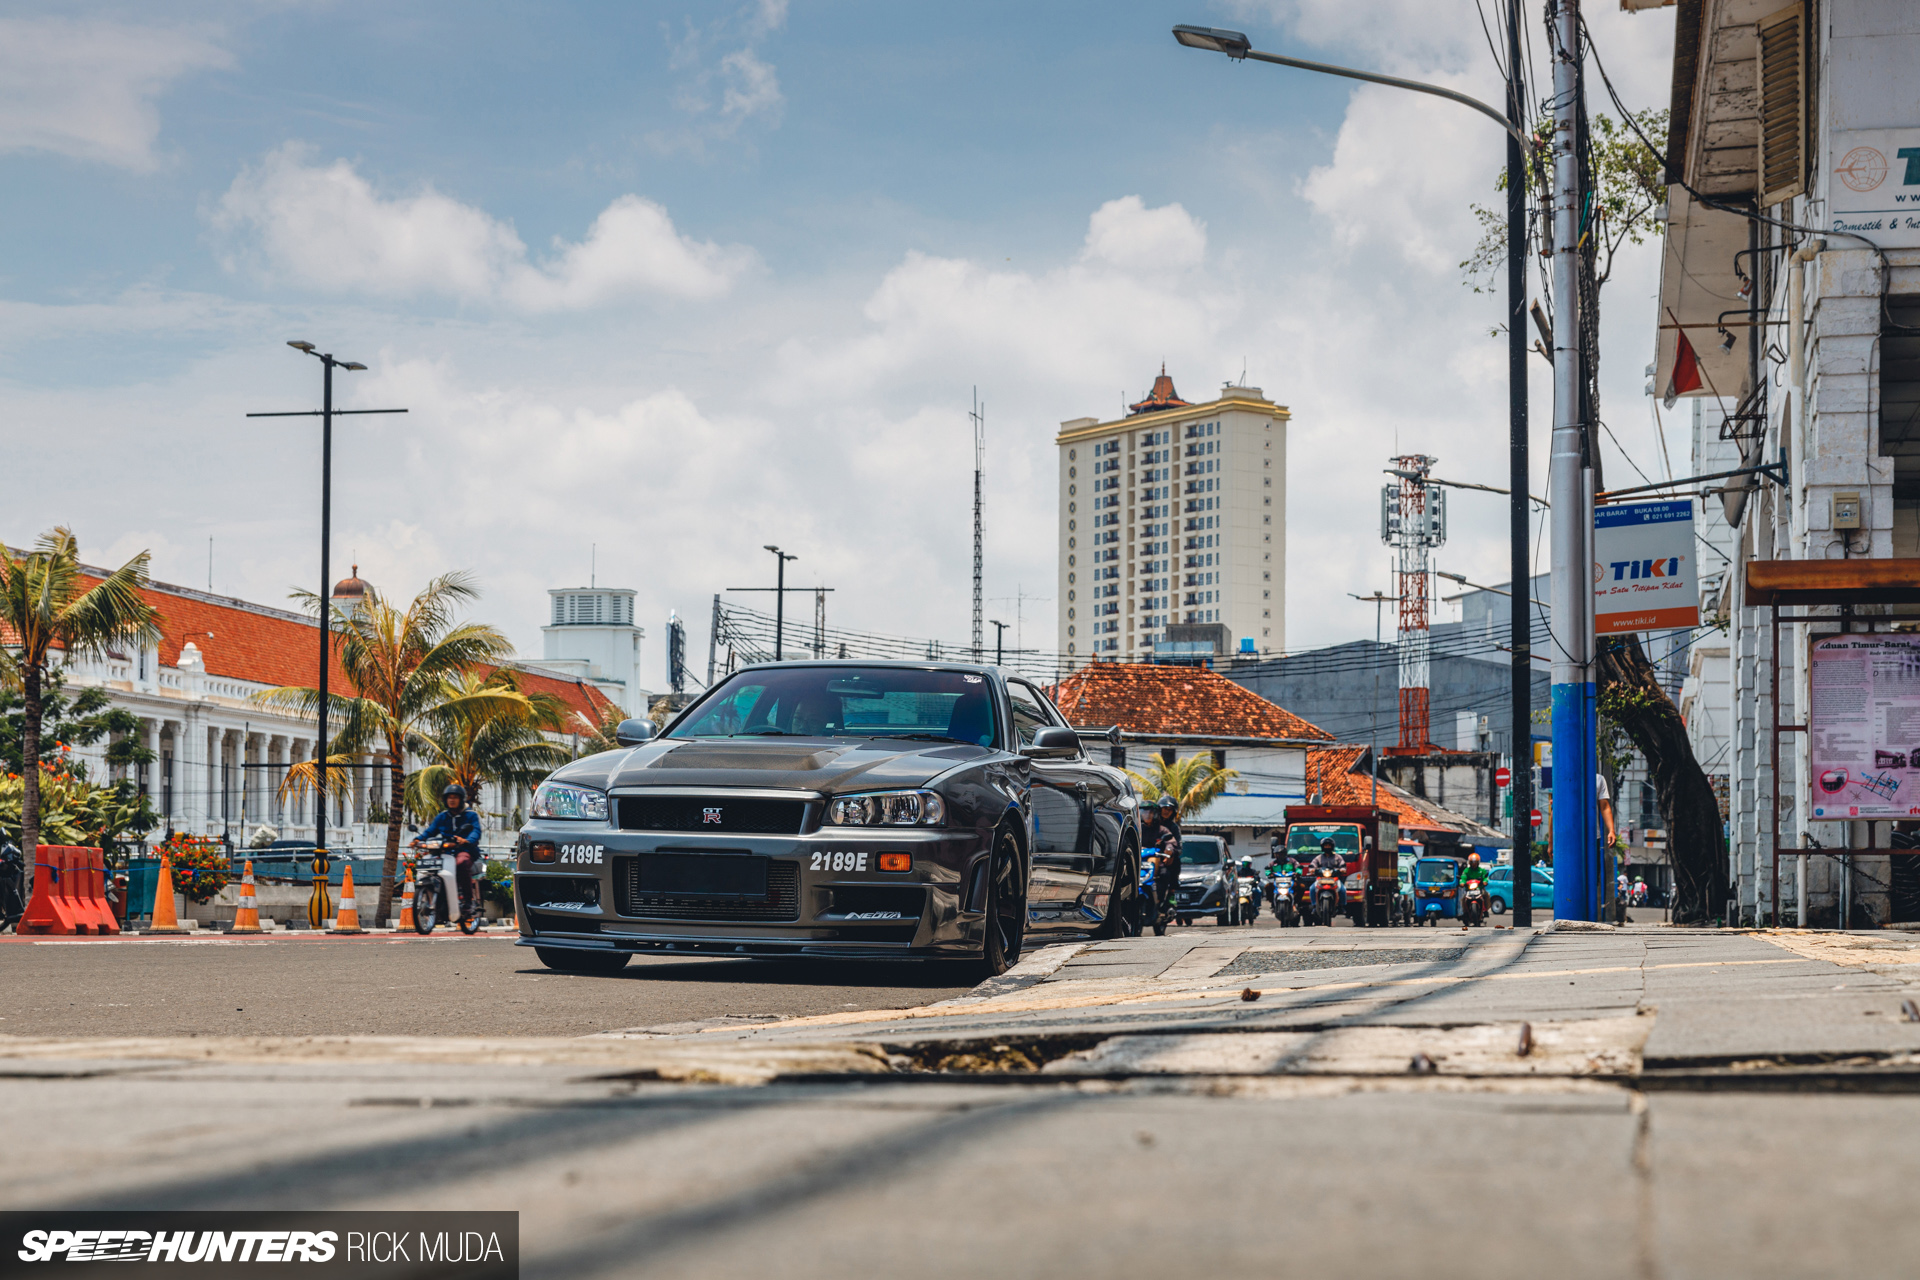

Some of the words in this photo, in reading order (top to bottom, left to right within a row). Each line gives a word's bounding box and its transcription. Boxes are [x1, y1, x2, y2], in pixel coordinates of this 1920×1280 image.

[1833, 219, 1882, 232] Domestik
[1889, 218, 1898, 229] &
[1606, 509, 1628, 517] BARAT
[1634, 507, 1653, 515] BUKA
[1653, 505, 1670, 513] 08.00
[1610, 586, 1629, 595] Satu
[1632, 583, 1660, 593] Titipan
[1662, 581, 1684, 589] Kilat
[1613, 616, 1656, 627] www.tiki.id
[703, 813, 721, 823] R
[560, 844, 604, 864] 2189E
[810, 851, 868, 872] 2189E
